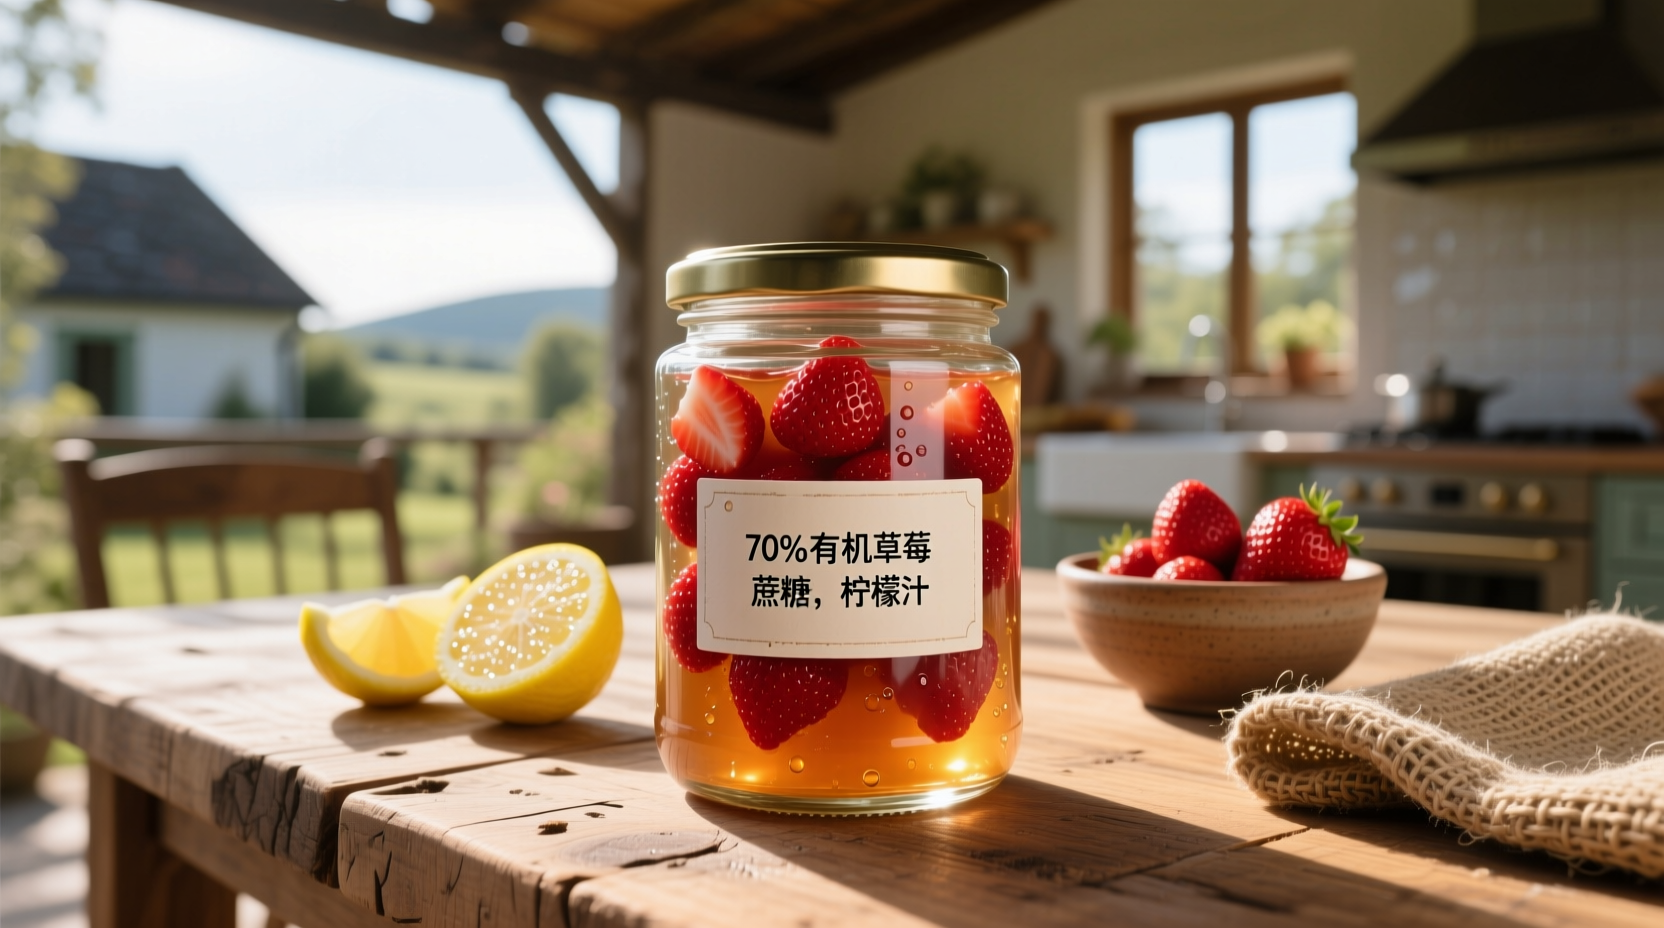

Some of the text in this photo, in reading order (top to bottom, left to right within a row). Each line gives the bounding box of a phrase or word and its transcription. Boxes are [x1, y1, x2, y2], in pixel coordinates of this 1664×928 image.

[745, 530, 932, 565] 70%有机草莓
[751, 574, 930, 610] 蔗糖，柠檬汁
